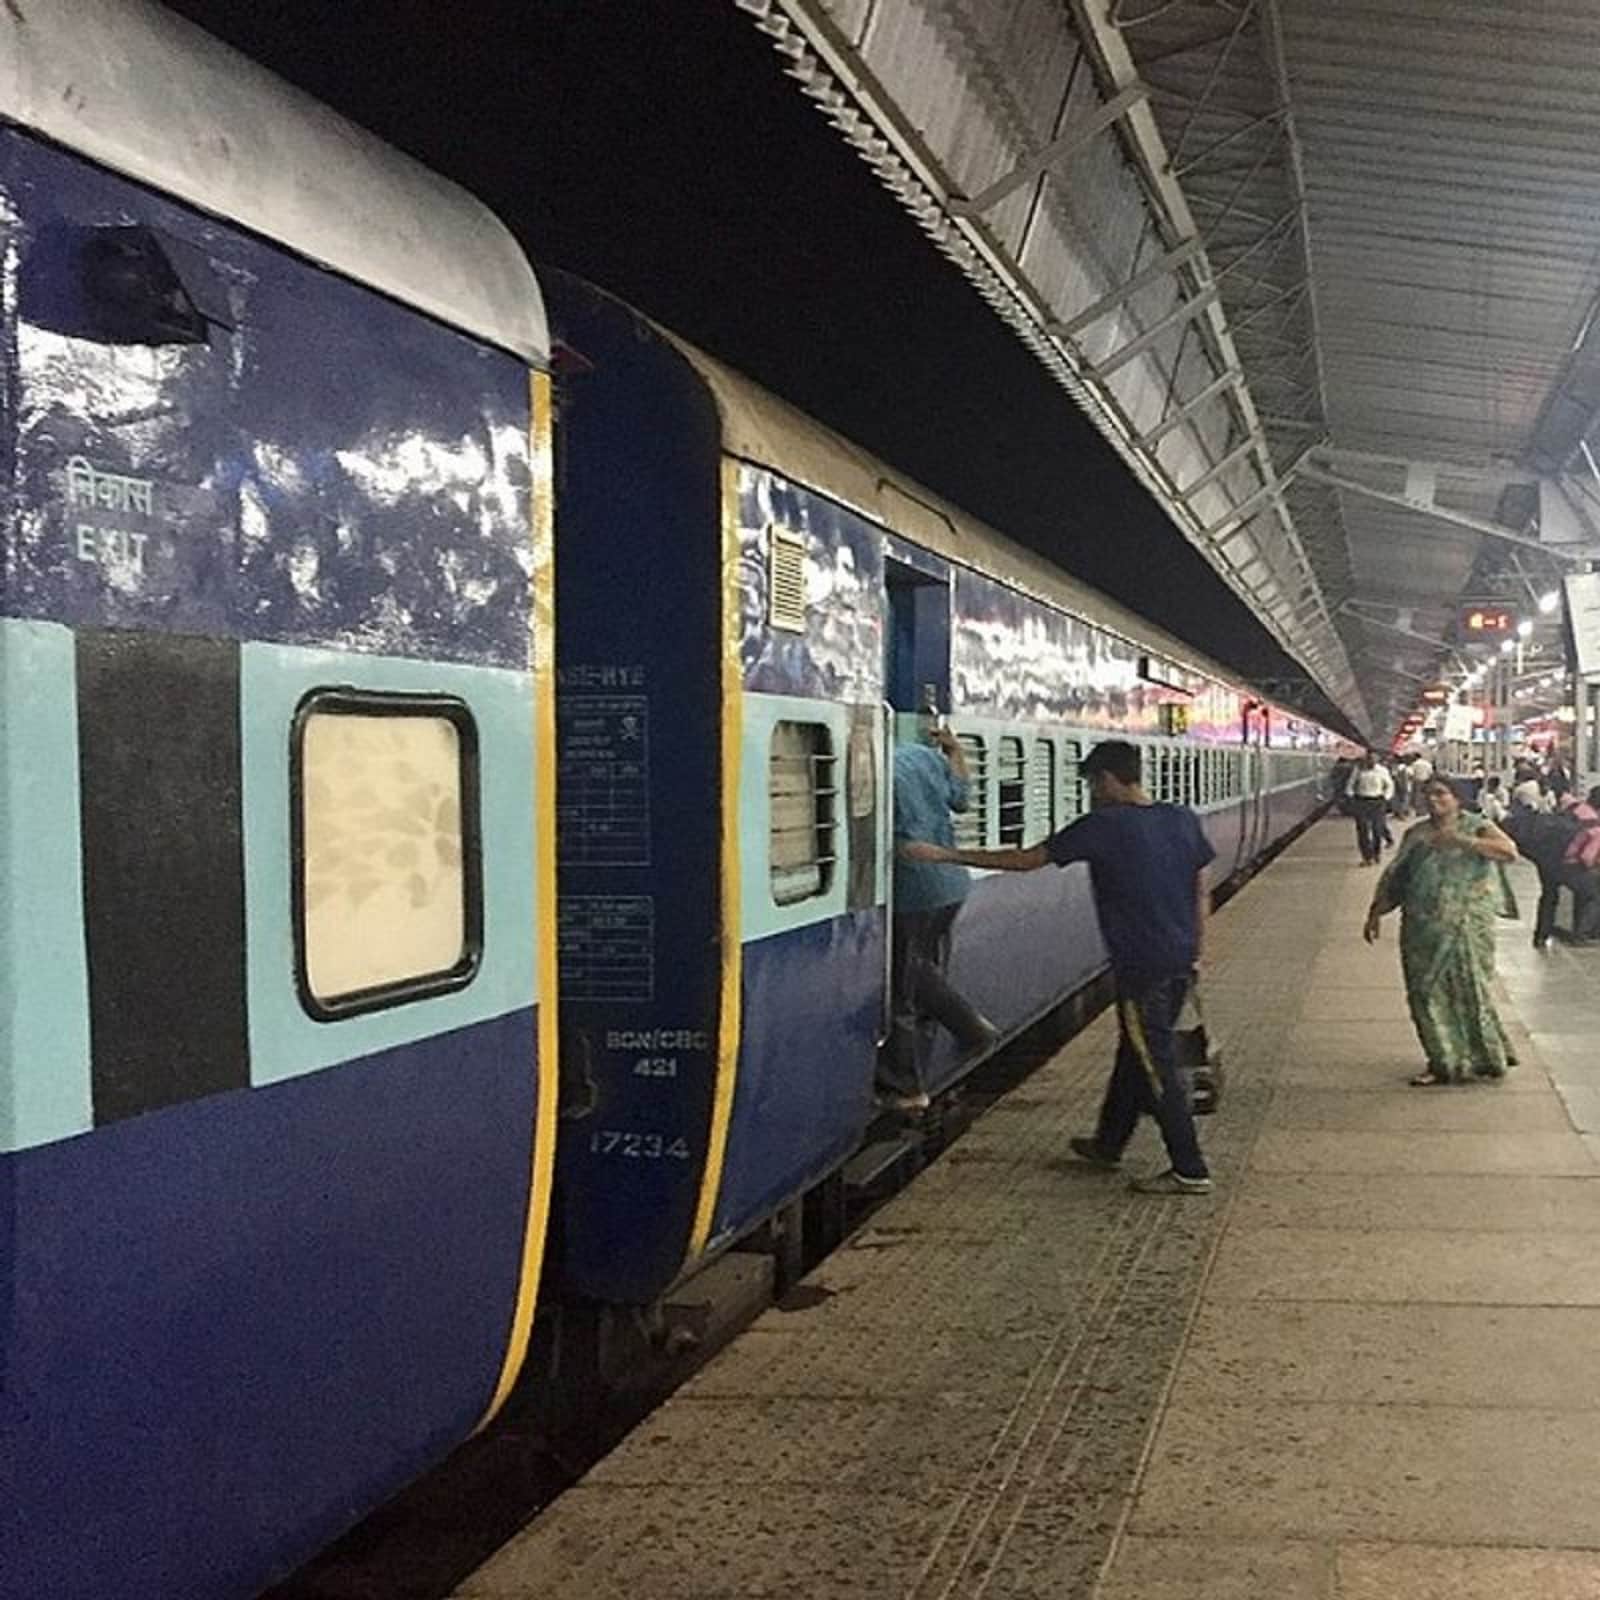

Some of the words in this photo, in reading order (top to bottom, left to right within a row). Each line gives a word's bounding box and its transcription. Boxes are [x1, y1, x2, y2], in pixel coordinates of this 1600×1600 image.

[66, 455, 152, 516] निकास
[77, 525, 149, 574] EXIT
[590, 1130, 690, 1160] 17234
